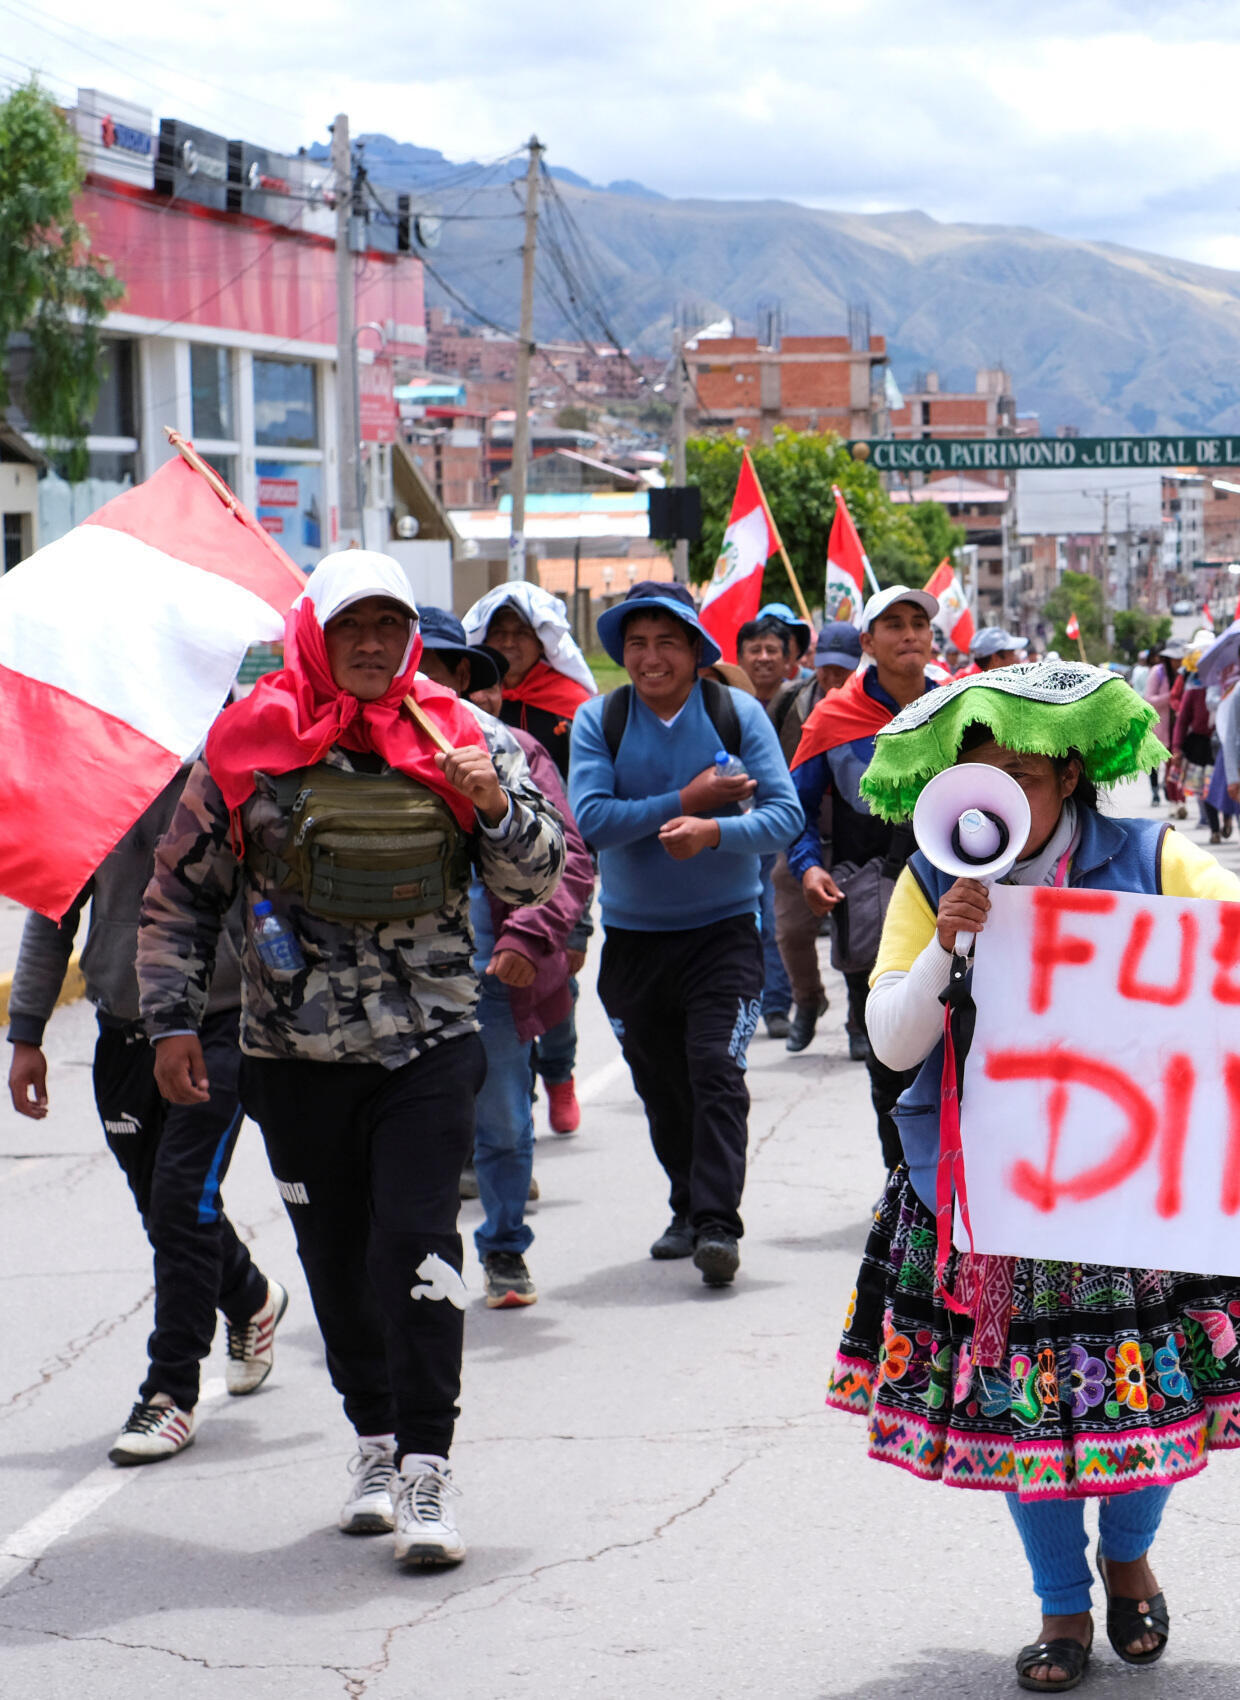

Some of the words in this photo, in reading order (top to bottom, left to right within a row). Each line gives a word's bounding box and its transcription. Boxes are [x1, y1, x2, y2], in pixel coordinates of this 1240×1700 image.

[873, 443, 945, 468] CUSCO,
[950, 441, 1076, 467] PATRIMONIO
[1196, 440, 1221, 463] DE
[104, 1119, 137, 1134] PUMA
